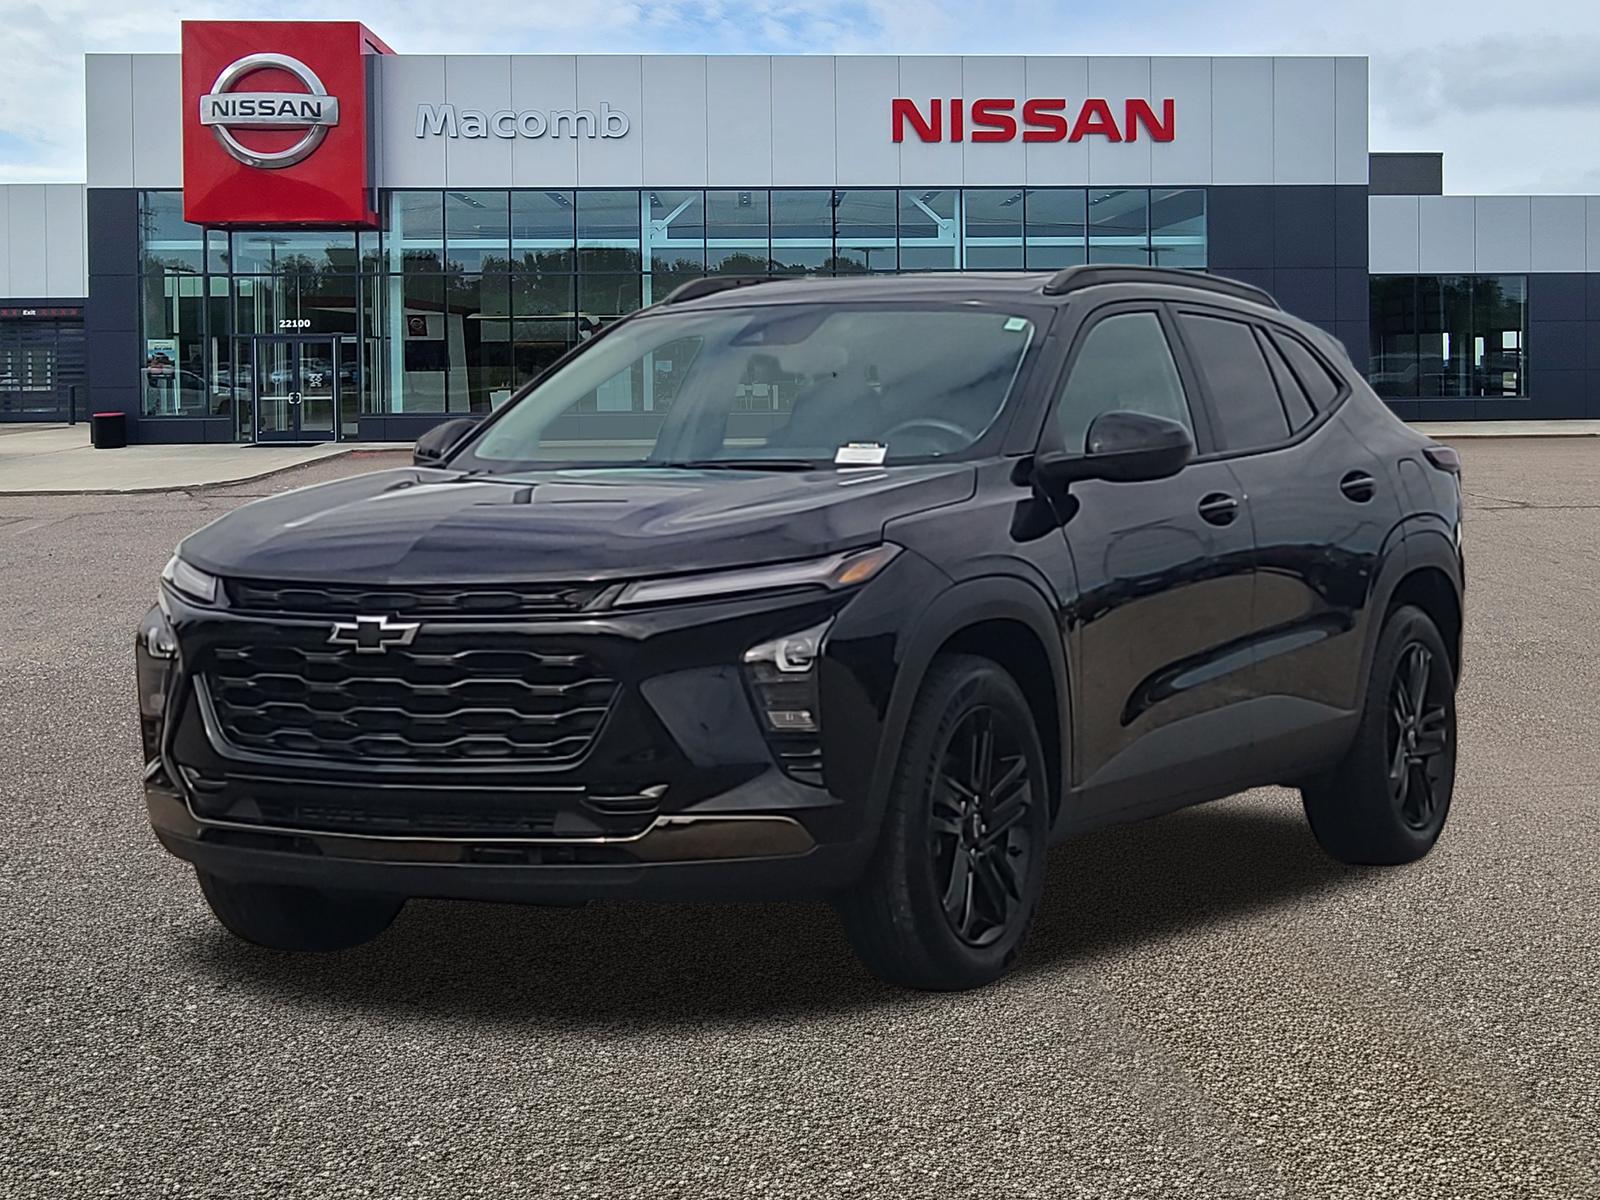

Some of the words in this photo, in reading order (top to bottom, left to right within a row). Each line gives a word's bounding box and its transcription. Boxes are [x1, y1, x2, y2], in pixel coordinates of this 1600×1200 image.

[212, 100, 321, 117] NISSAN
[415, 102, 630, 138] Macomb
[892, 98, 1175, 143] NISSAN
[279, 319, 311, 328] 22100
